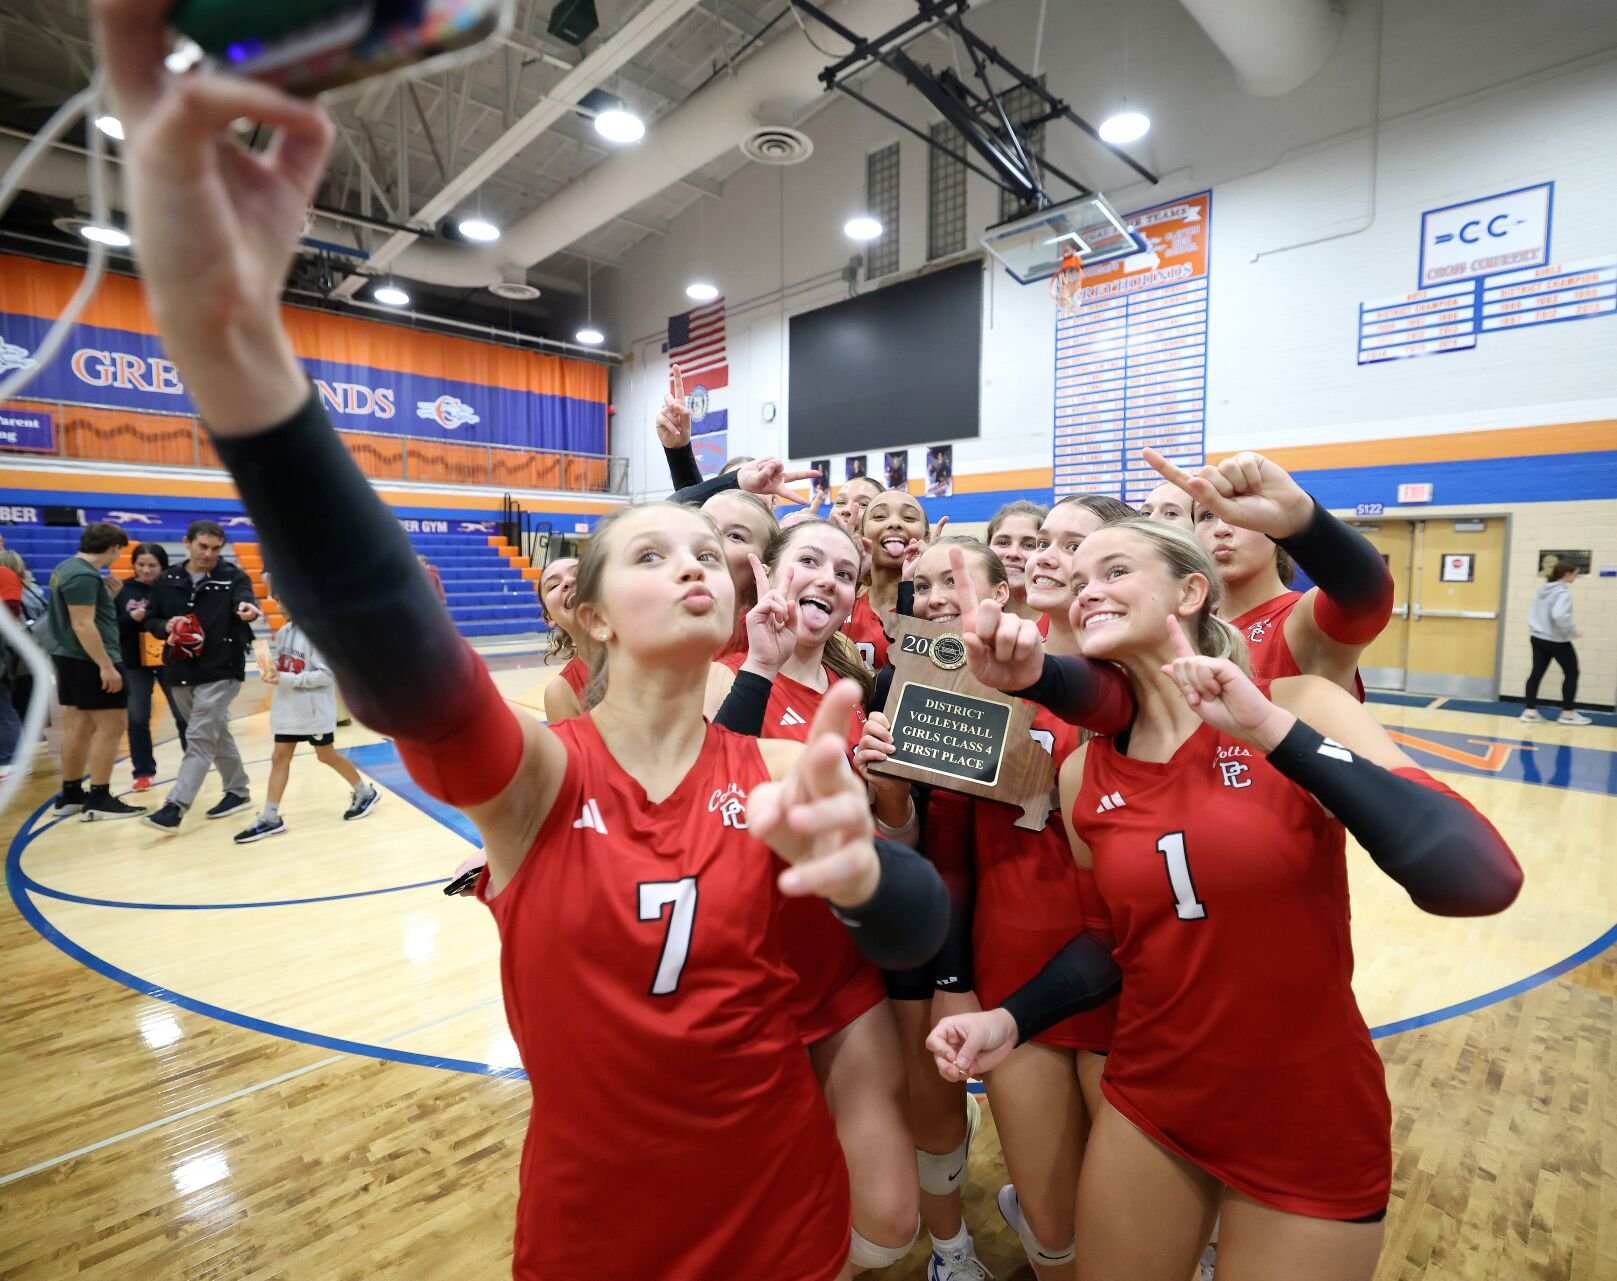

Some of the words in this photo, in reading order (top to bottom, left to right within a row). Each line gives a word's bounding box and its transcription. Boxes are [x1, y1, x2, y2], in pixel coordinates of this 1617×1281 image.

[422, 520, 448, 533] GYM
[903, 635, 929, 654] 20
[925, 698, 985, 720] DISTRICT
[909, 710, 993, 739] VOLLEYBALL
[902, 725, 941, 743] GIRLS
[943, 735, 983, 753] CLASS
[985, 745, 993, 755] 4
[902, 741, 940, 759] FIRST
[941, 751, 984, 770] PLACE
[1155, 829, 1208, 921] 1
[637, 875, 699, 997] 7
